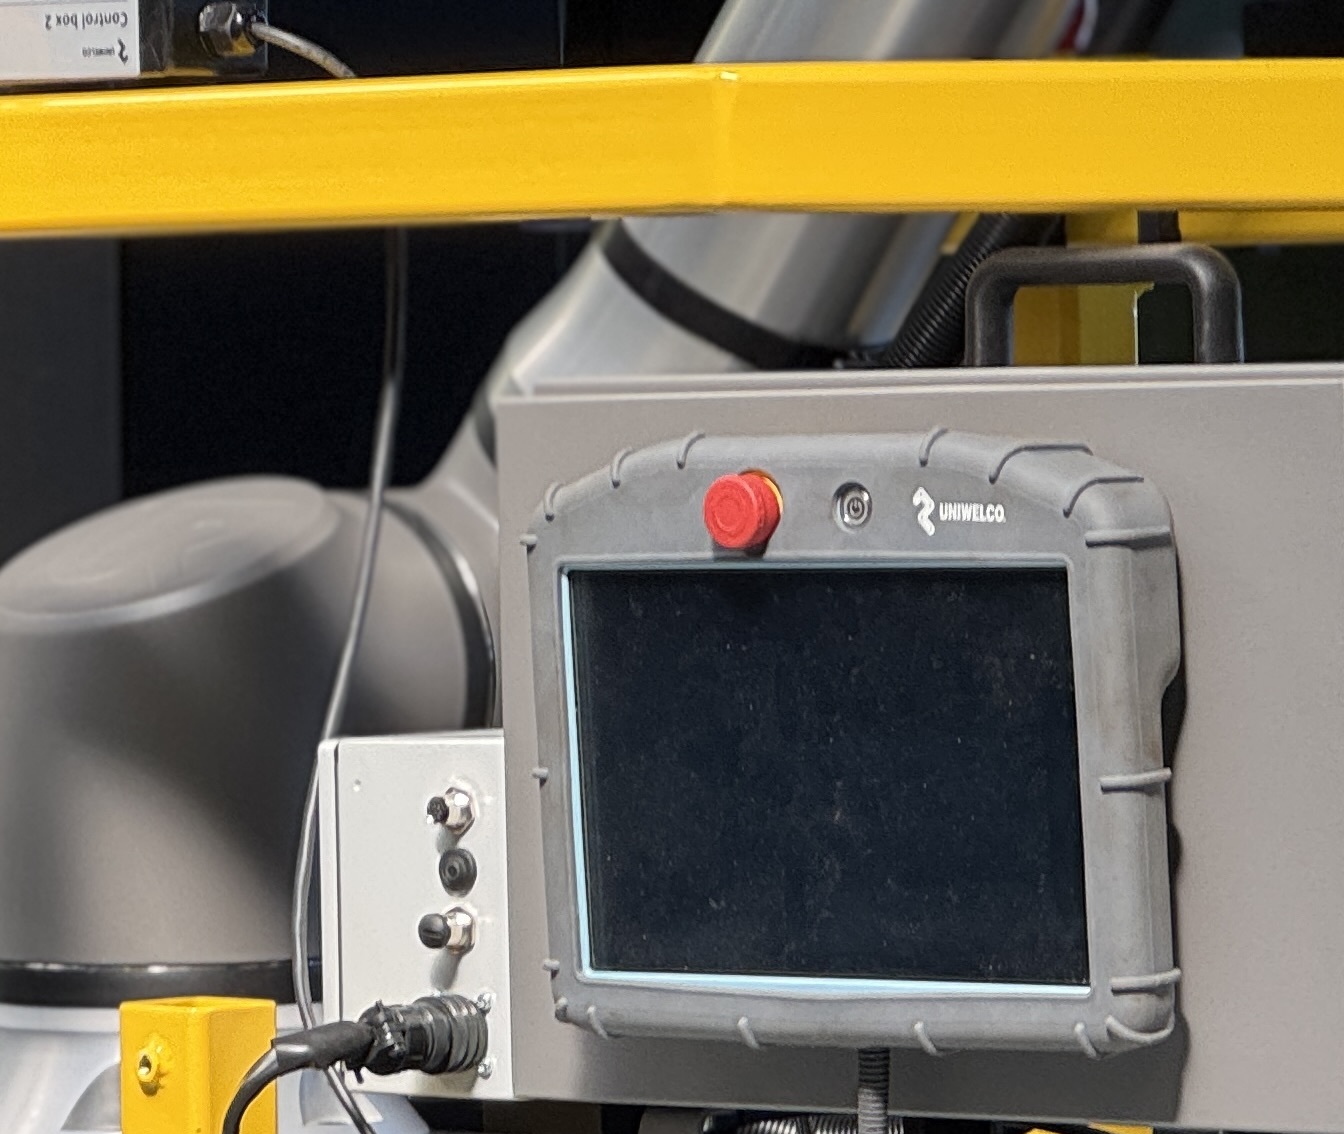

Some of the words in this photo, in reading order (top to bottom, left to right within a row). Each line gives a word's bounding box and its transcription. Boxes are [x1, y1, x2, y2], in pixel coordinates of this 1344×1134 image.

[45, 13, 52, 30] 2
[56, 12, 78, 30] box
[82, 11, 128, 30] Control
[939, 502, 1005, 523] UNIWELCO
